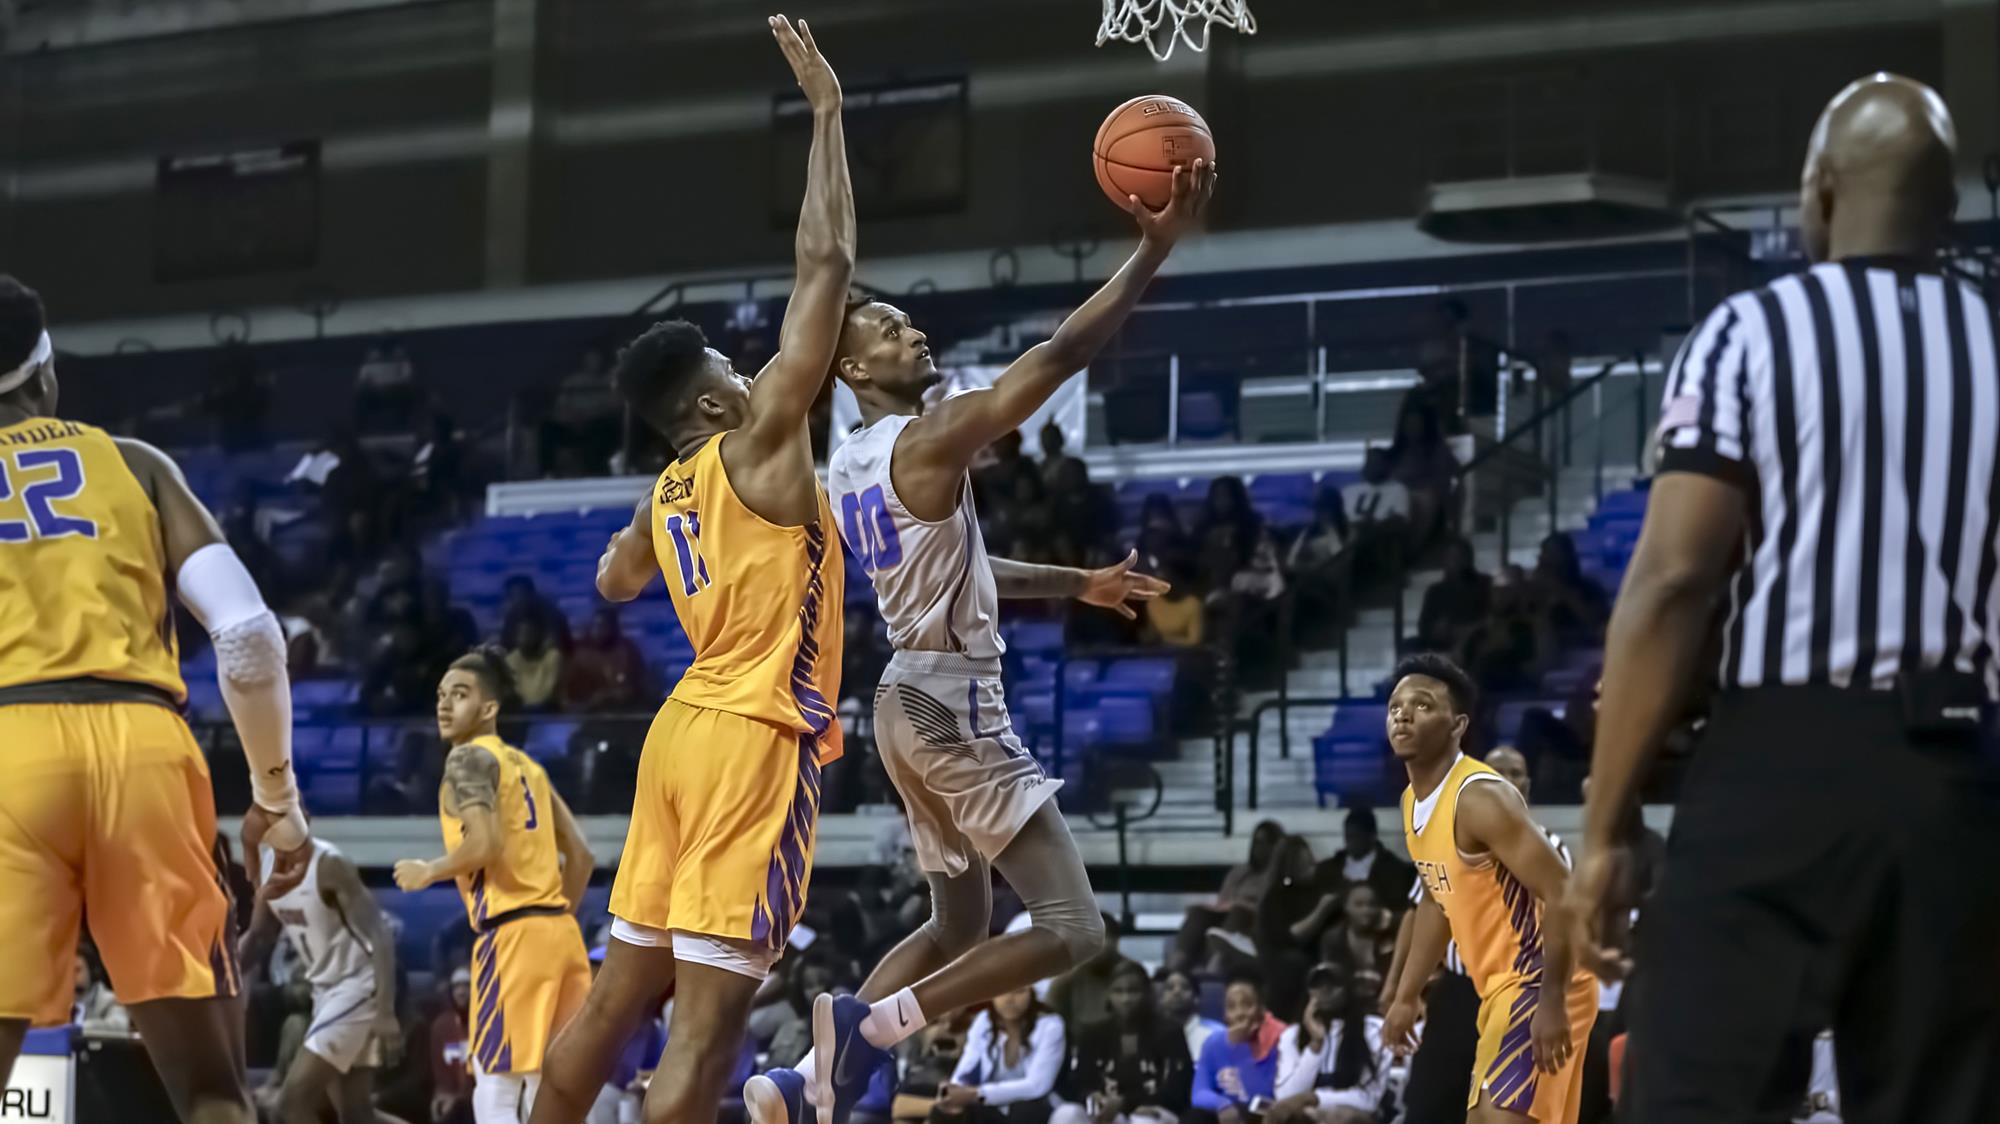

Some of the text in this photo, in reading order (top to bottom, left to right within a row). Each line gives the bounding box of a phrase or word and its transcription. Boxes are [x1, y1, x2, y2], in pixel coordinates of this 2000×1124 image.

[665, 507, 713, 598] 11
[841, 482, 904, 573] 00
[1416, 860, 1454, 894] ECH
[1, 1088, 51, 1118] RU
